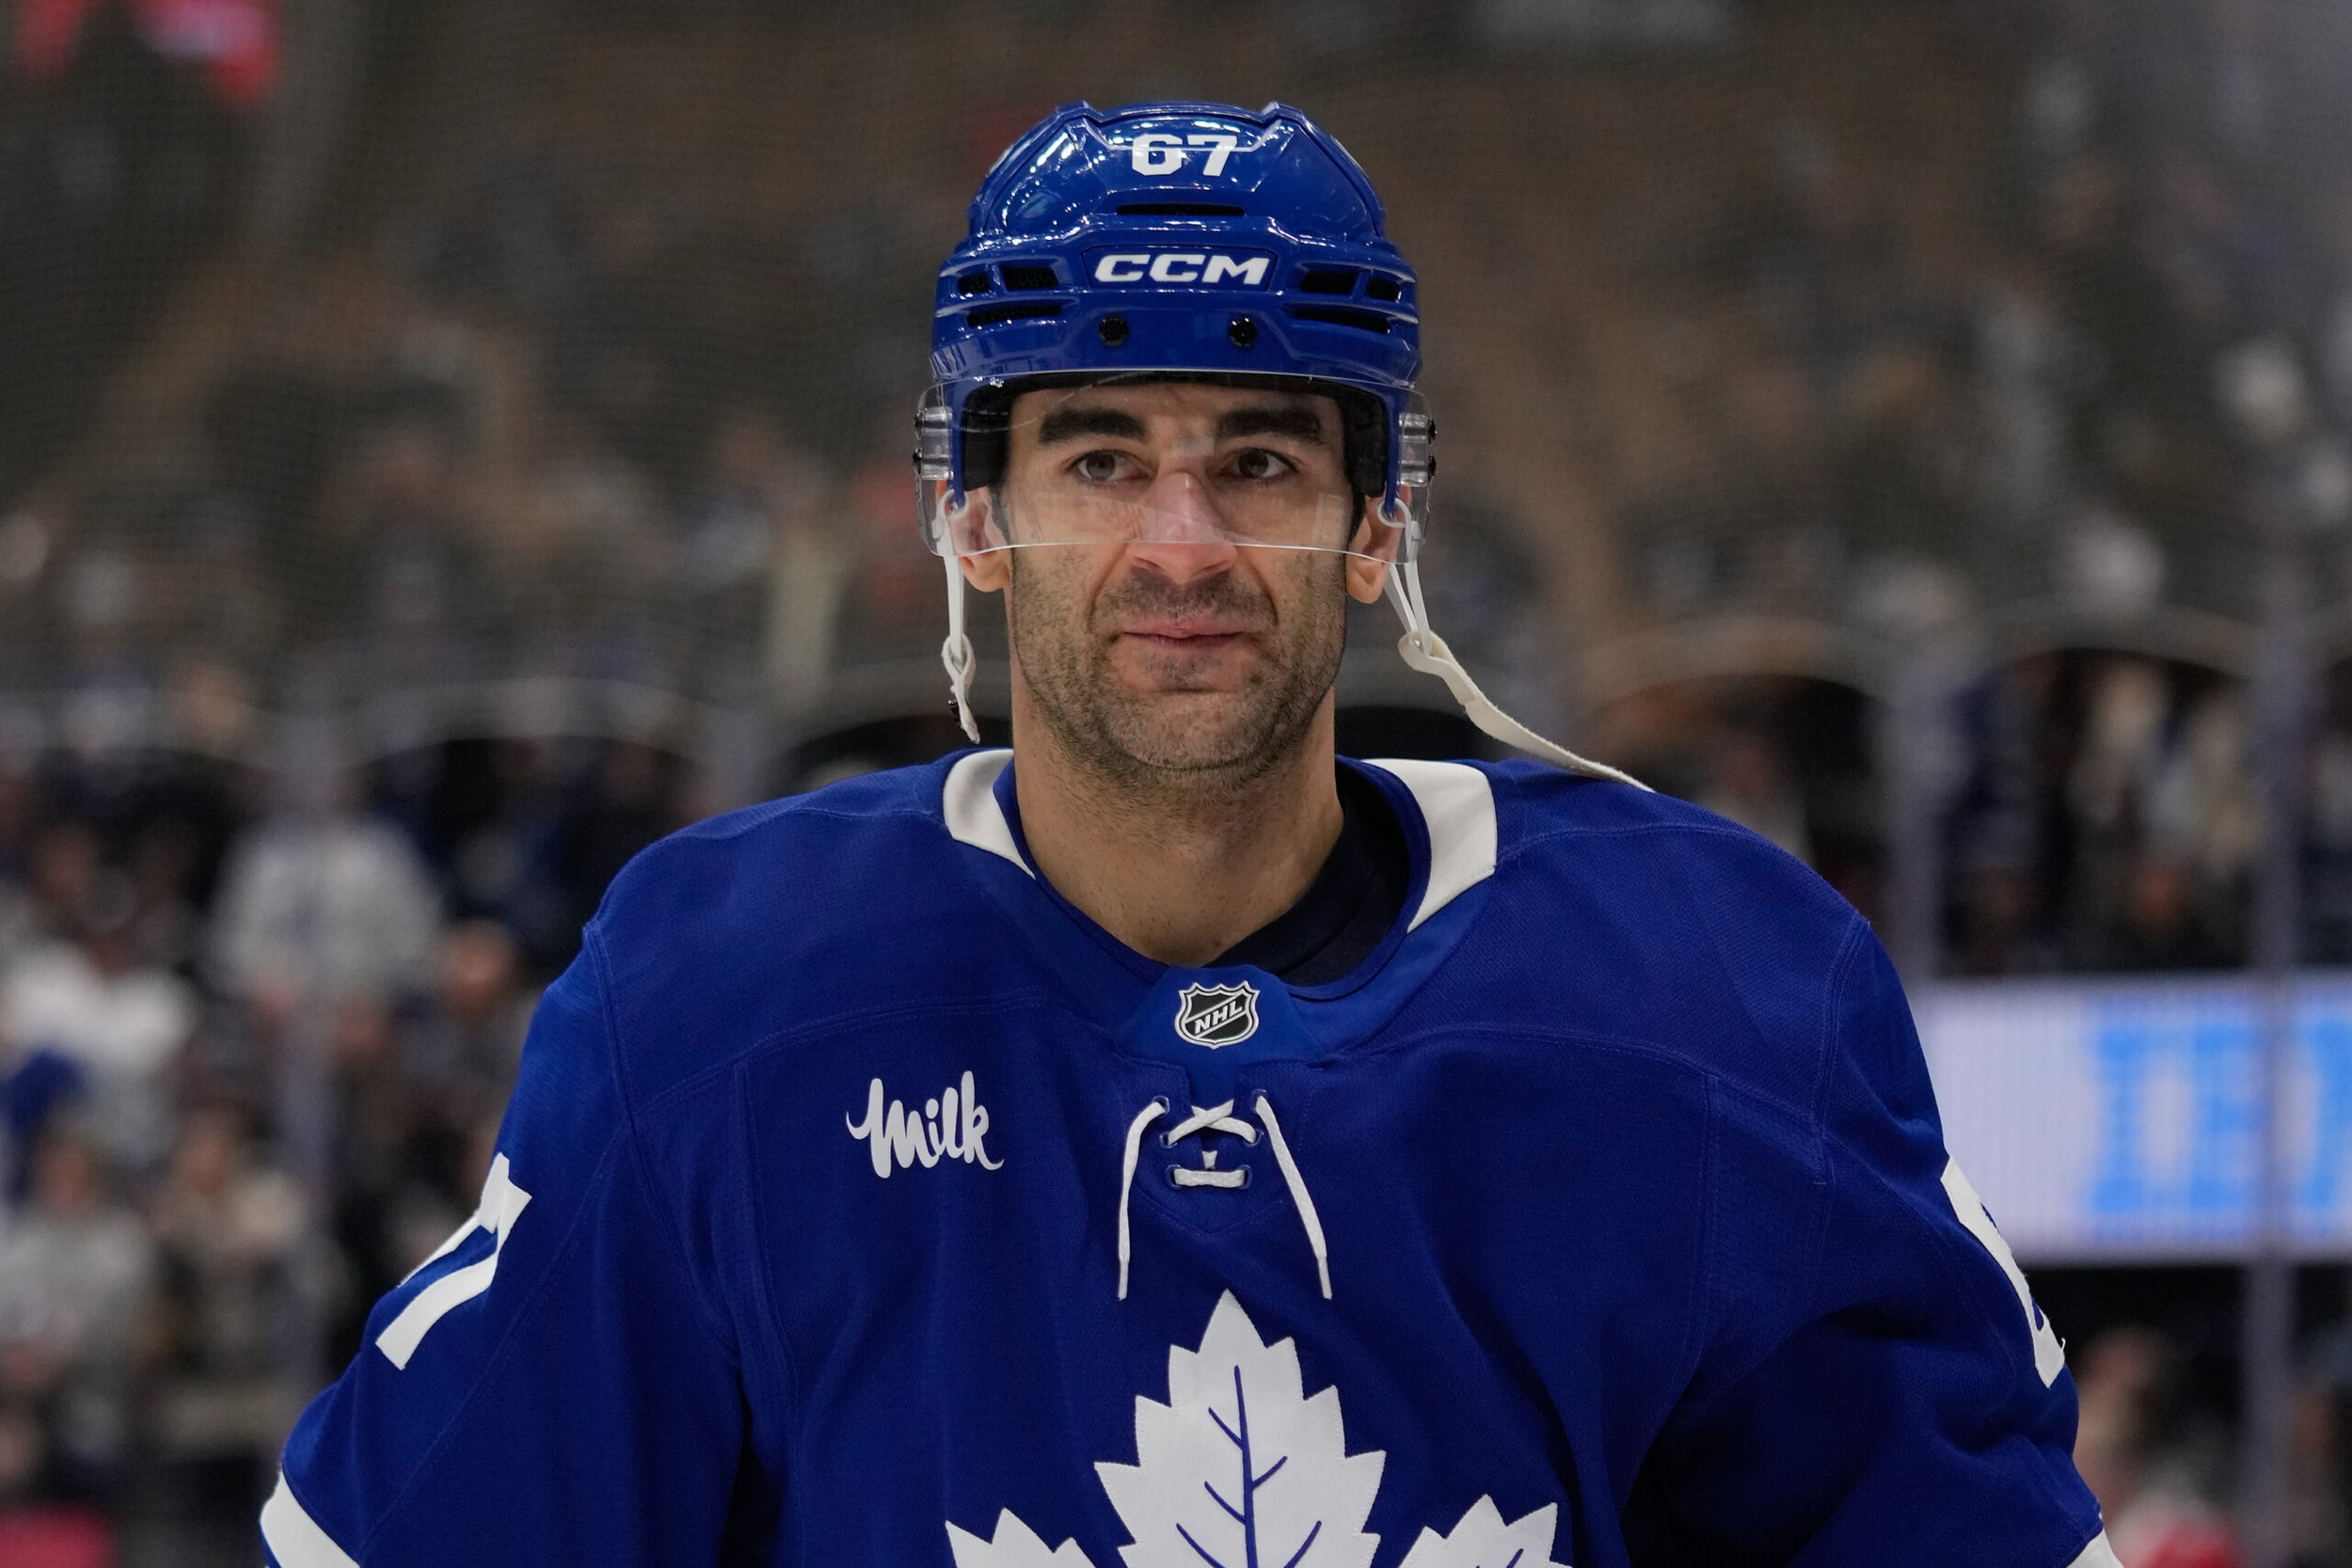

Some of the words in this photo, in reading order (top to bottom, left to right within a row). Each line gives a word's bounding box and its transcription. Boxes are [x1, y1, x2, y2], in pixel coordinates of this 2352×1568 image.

[1132, 134, 1237, 177] 67
[1094, 253, 1270, 285] CCM
[1195, 1000, 1243, 1035] NHL
